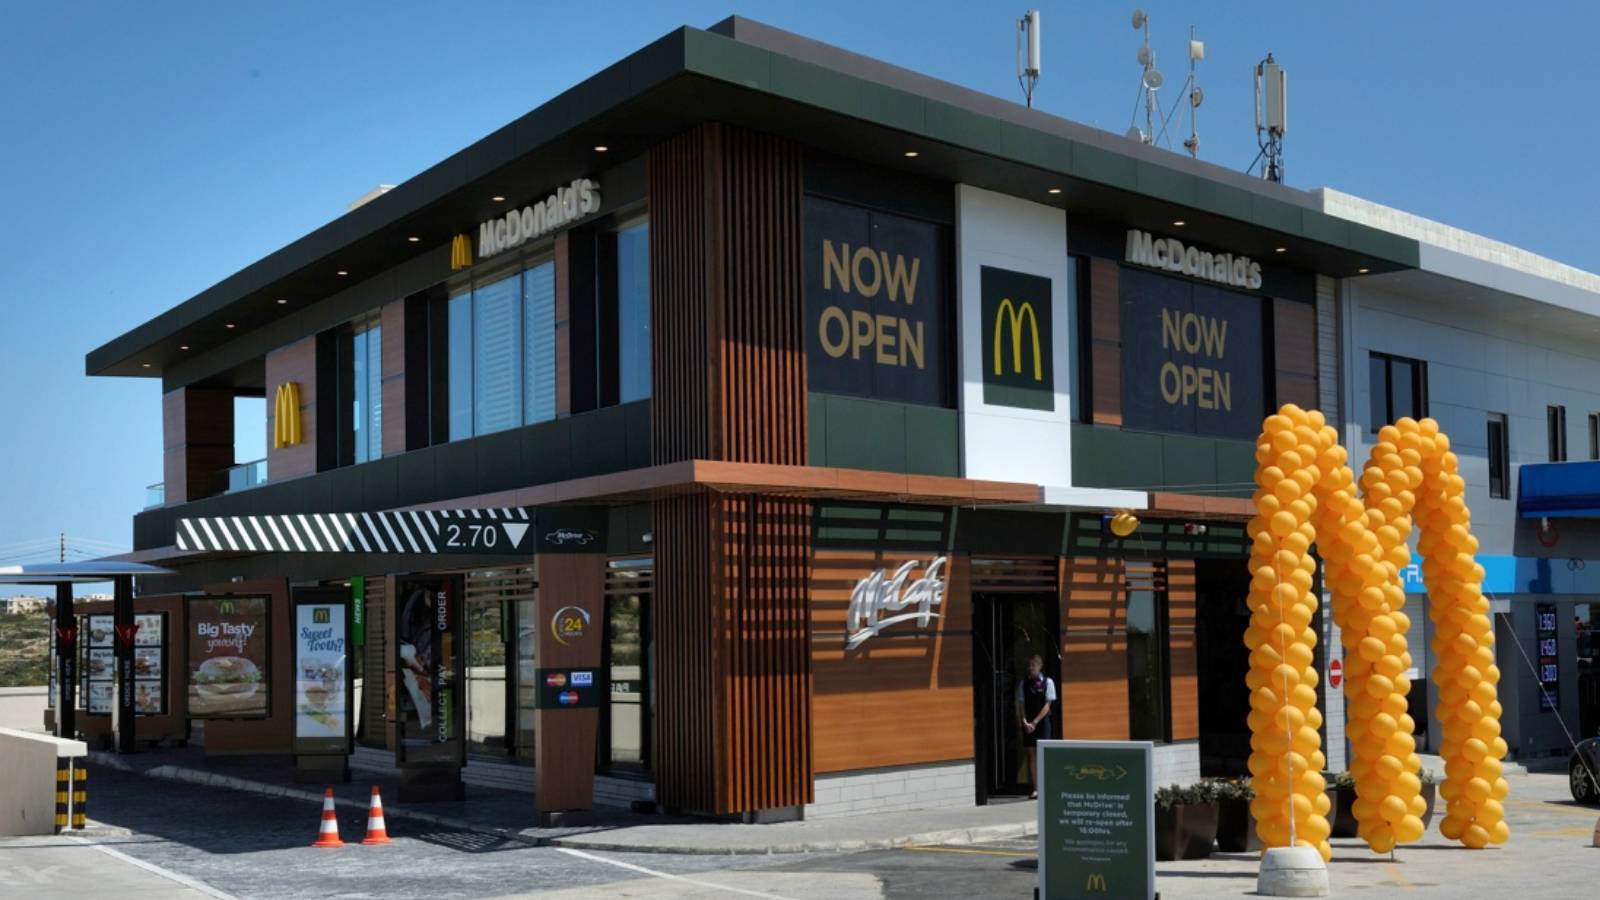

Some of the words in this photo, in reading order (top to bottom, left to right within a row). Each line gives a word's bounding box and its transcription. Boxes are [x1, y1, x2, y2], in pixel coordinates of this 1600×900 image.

[479, 178, 600, 258] McDonald's
[1126, 229, 1263, 290] McDonald's
[823, 239, 920, 305] NOW
[818, 305, 925, 369] OPEN
[1161, 307, 1228, 360] NOW
[1160, 361, 1231, 412] OPEN
[446, 525, 497, 548] 2.70
[353, 598, 361, 624] NEWS
[437, 591, 447, 630] ORDER
[197, 623, 219, 638] Big
[221, 622, 255, 637] Tasty
[300, 627, 333, 642] Sweet
[564, 617, 583, 632] 24
[307, 638, 344, 653] Tooth?
[438, 664, 448, 686] PAY
[573, 673, 591, 681] VISA
[438, 691, 448, 743] COLLECT
[1061, 791, 1084, 800] Please
[1086, 792, 1095, 800] be
[1097, 792, 1130, 801] informed
[1071, 817, 1084, 825] will
[1115, 819, 1133, 827] after
